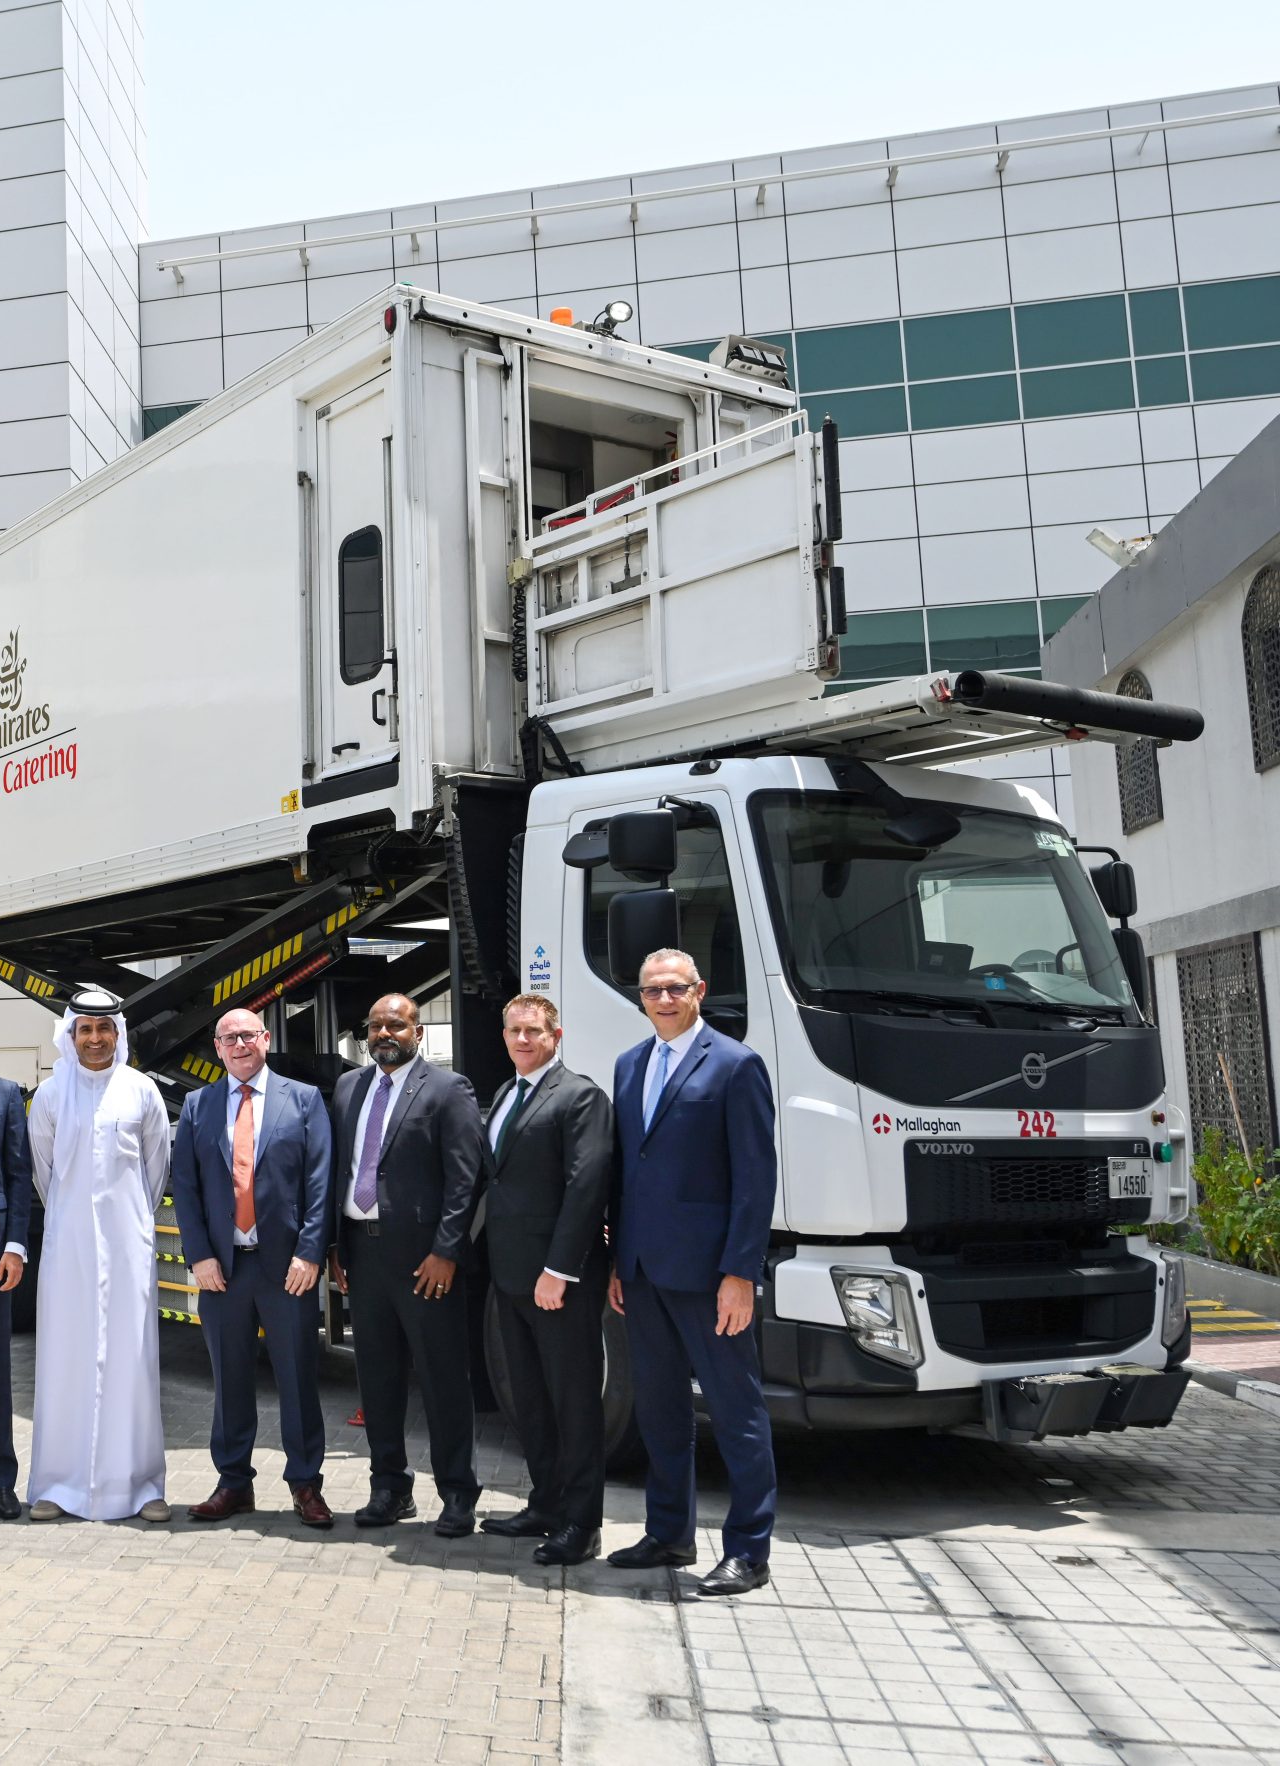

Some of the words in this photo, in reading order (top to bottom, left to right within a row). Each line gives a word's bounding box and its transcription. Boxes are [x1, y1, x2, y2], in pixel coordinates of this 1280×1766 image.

[3, 743, 77, 794] Catering
[896, 1117, 961, 1135] Mallaghan
[1017, 1110, 1056, 1137] 242
[915, 1143, 974, 1155] VOLVO
[1142, 1160, 1148, 1173] L
[1118, 1175, 1146, 1195] 14550
